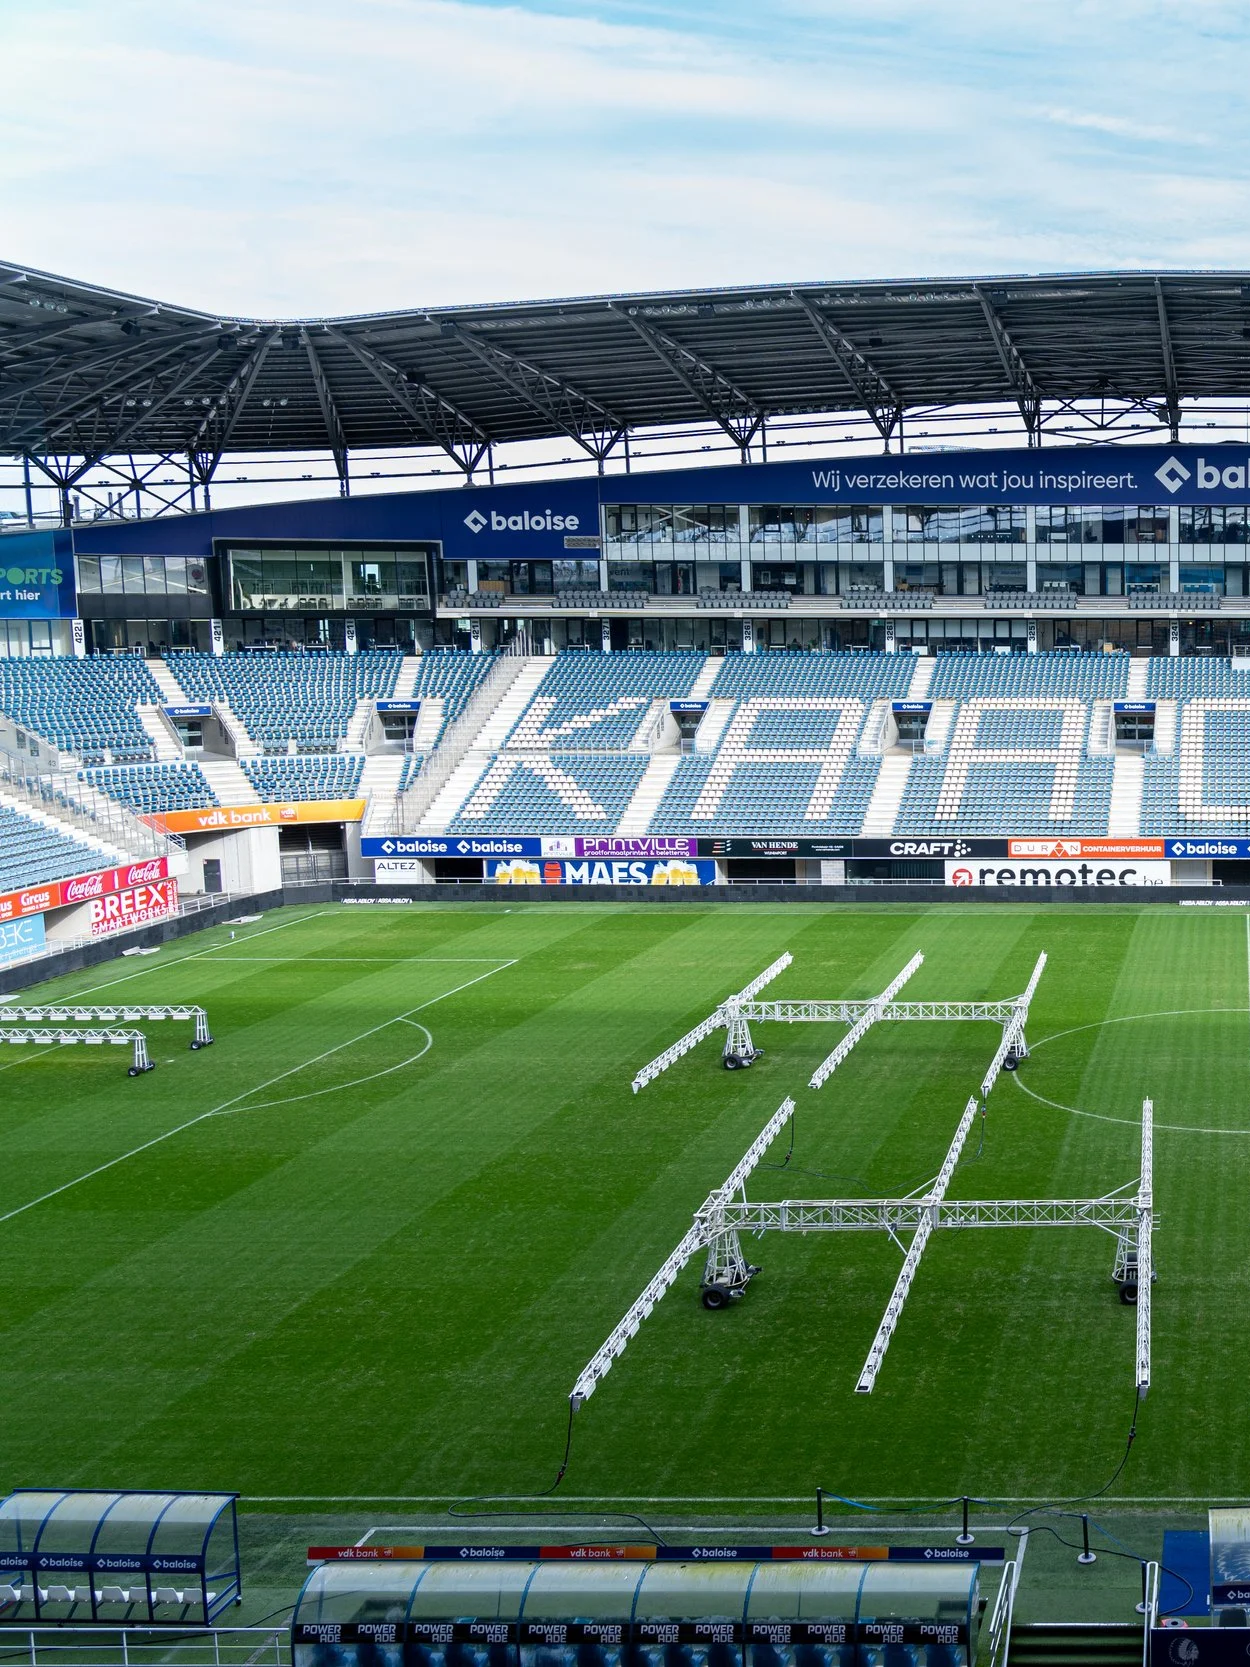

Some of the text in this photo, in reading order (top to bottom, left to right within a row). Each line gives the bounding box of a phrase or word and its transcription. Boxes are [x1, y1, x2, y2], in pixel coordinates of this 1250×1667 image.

[812, 469, 1138, 492] Wij verzekeren wat jou inspireert.
[491, 509, 580, 531] baloise
[15, 589, 41, 600] hier
[74, 626, 83, 644] 422
[1171, 624, 1179, 641] 324
[198, 808, 271, 827] vdk bank
[397, 839, 448, 853] baloise
[472, 839, 523, 853] baloise
[751, 841, 799, 849] VAN HENDE
[889, 842, 954, 855] CRAFT
[1082, 845, 1162, 853] CONTAINERVERHUUR
[1187, 841, 1238, 855] baloise
[656, 849, 690, 857] belettering
[377, 862, 416, 870] ALTEZ
[565, 861, 649, 885] MAES
[979, 863, 1137, 886] remotec
[20, 891, 50, 907] Circus
[89, 881, 166, 922] BREEX
[338, 1548, 355, 1558] vdk
[356, 1548, 379, 1558] bank
[470, 1547, 505, 1558] baloise
[570, 1548, 611, 1558] vdk bank
[702, 1547, 738, 1558] baloise
[802, 1548, 844, 1558] vdk bank
[934, 1548, 970, 1558] baloise
[0, 1556, 29, 1566] aloise
[50, 1557, 84, 1567] baloise
[106, 1558, 141, 1568] baloise
[163, 1559, 197, 1569] baloise
[303, 1624, 341, 1635] POWER
[470, 1624, 508, 1635] POWER
[752, 1625, 791, 1635] POWER
[920, 1625, 959, 1635] POWER
[320, 1634, 341, 1643] ADE
[487, 1634, 508, 1643] ADE
[769, 1634, 791, 1643] ADE
[937, 1634, 959, 1644] ADE
